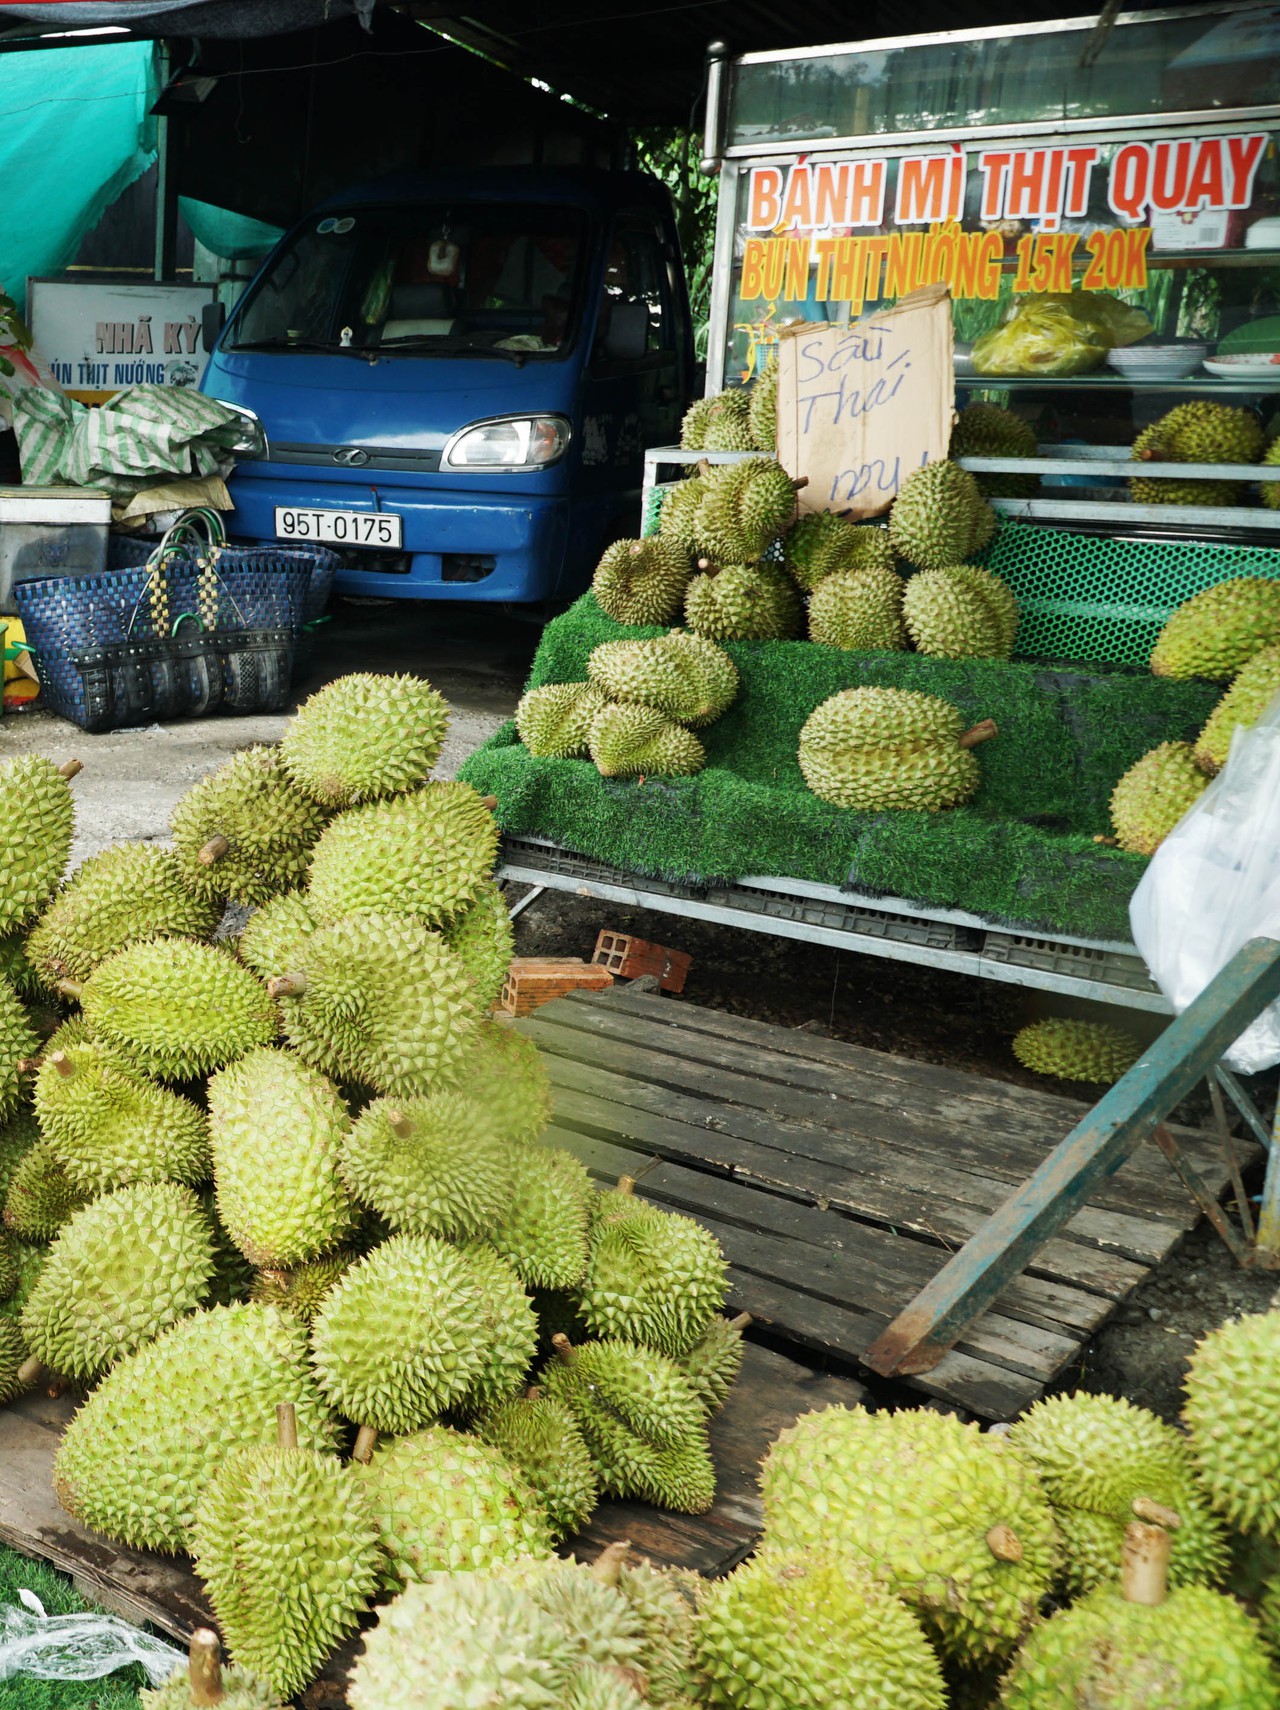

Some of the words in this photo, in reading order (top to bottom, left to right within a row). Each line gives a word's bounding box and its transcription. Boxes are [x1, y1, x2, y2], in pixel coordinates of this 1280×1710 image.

[749, 155, 886, 230] BÁNH
[895, 143, 967, 225] MÌ
[979, 145, 1099, 231] THỊT
[1109, 133, 1268, 222] QUAY
[740, 220, 810, 301] BÚN
[1013, 232, 1078, 293] 15K
[1083, 228, 1151, 290] 20K
[96, 316, 153, 354] NHÃ
[48, 358, 72, 385] ÚN
[78, 363, 109, 390] THỊT
[114, 358, 165, 385] NƯỚNG
